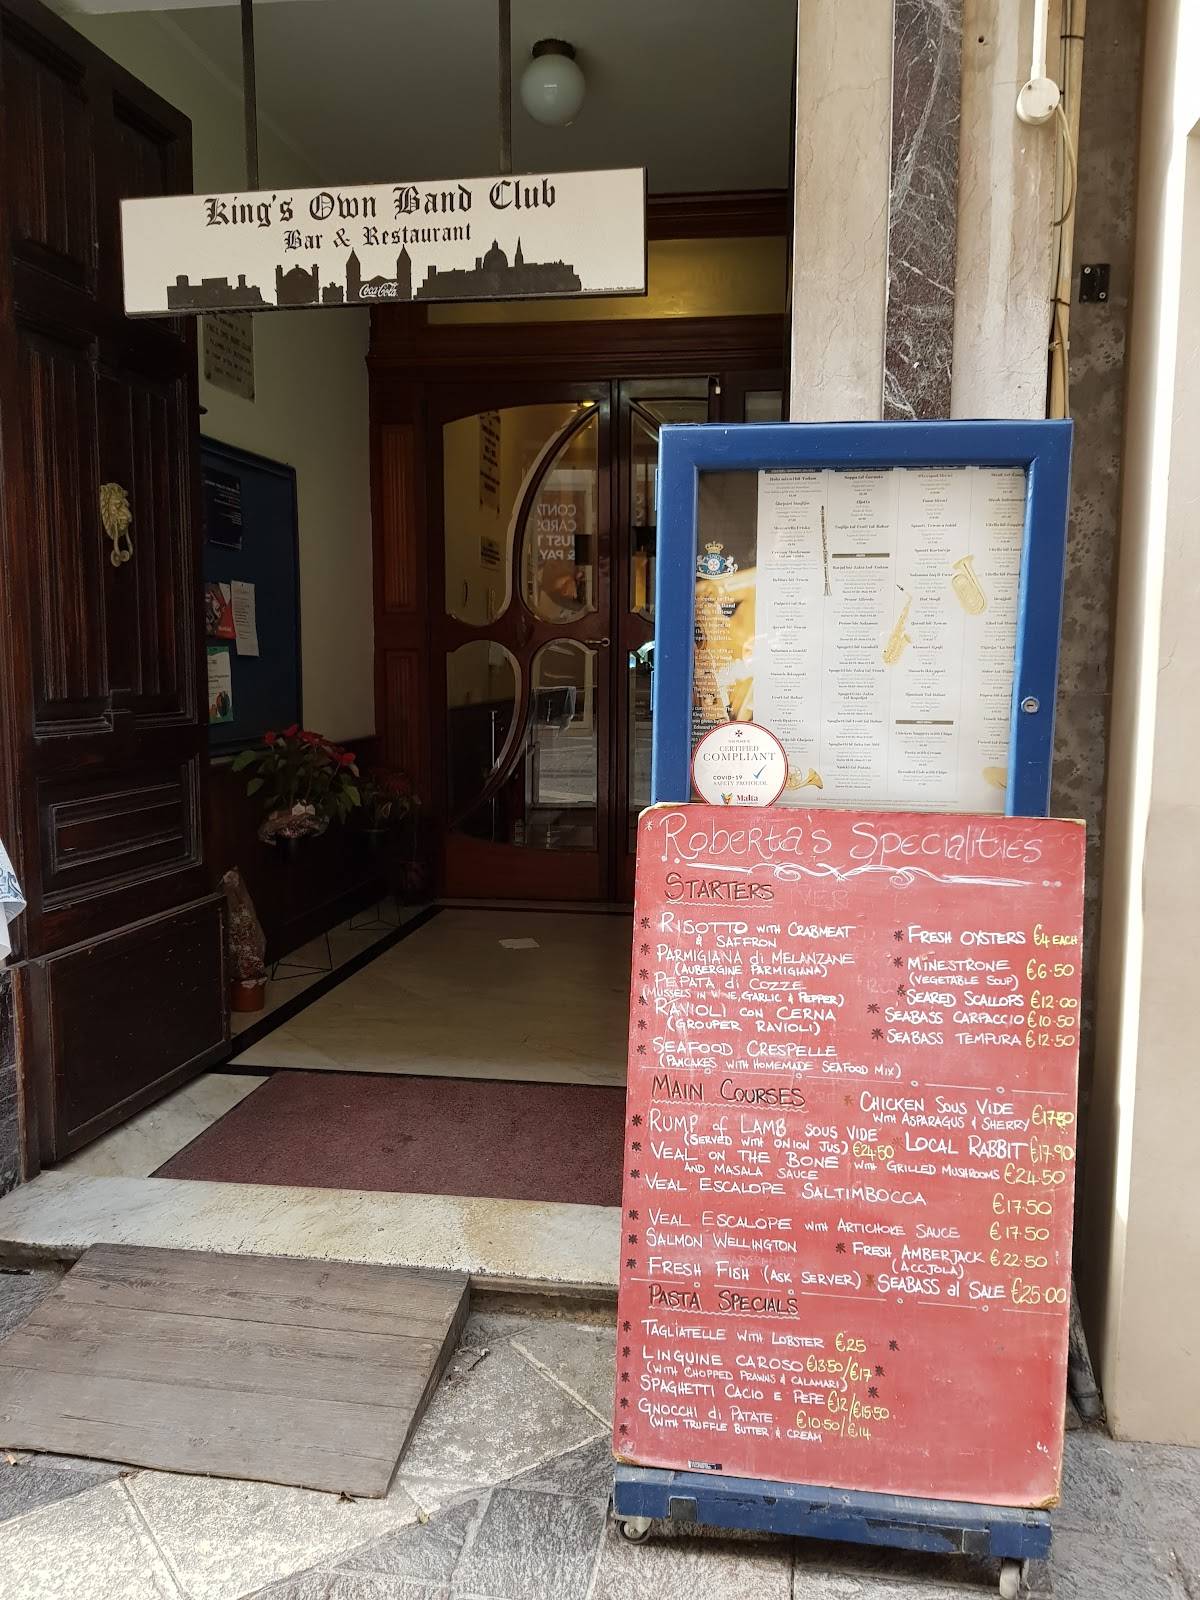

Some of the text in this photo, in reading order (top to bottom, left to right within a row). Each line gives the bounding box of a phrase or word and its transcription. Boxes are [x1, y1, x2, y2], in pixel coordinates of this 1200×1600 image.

[205, 178, 556, 227] King's Own Band Club
[284, 223, 471, 251] Bar & Restaurant
[703, 752, 776, 761] COMPLIANT
[664, 872, 774, 902] STARTERS
[661, 912, 748, 934] RISOTTO
[788, 922, 856, 938] CRABMEAT
[908, 924, 1078, 948] FRESH OYSTERS €4 EACH
[656, 943, 855, 965] PARMIGIANA di MELANZANE
[716, 936, 777, 948] SAFFRON
[674, 963, 828, 977] (AUBERGINE PARMIGIANA)
[907, 957, 1011, 972] MINESTRONE
[654, 971, 807, 990] PEPATA di COZZE
[909, 974, 979, 987] (VEGETABLE
[986, 974, 1019, 991] SOUP)
[655, 998, 836, 1021] RAVIOLI CON CERNA
[799, 992, 845, 1006] PEPPER)
[905, 989, 956, 1008] SEARED
[963, 991, 1024, 1007] SCALLOPS
[666, 1016, 821, 1035] (GROUPER RAVIOLI)
[884, 1007, 944, 1024] SEABASS
[952, 1011, 1025, 1024] CARPACCIO
[652, 1036, 837, 1057] SEAFOOD CRESPELLE
[886, 1029, 944, 1045] SEABASS
[955, 1032, 1022, 1046] TEMPURA
[659, 1053, 717, 1067] (PANCAKES
[725, 1060, 749, 1069] WITH
[753, 1060, 814, 1071] HOMEMADE
[822, 1060, 868, 1074] SEAFOOD
[652, 1074, 806, 1108] MAIN COURSES
[860, 1090, 1014, 1115] CHICKEN SOUS VIDE
[649, 1108, 699, 1133] RUMP
[740, 1114, 787, 1137] LAMB
[804, 1124, 838, 1138] SOUS
[846, 1126, 879, 1142] VIDE
[901, 1113, 965, 1129] ASPARAGUS
[981, 1117, 1030, 1132] SHERRY
[683, 1133, 732, 1146] (SERVED
[773, 1140, 810, 1151] ONION
[819, 1141, 849, 1155] JUS)
[905, 1132, 959, 1155] LOCAL
[968, 1135, 1029, 1160] RABBIT
[650, 1141, 698, 1162] VEAL
[708, 1151, 725, 1161] ON
[737, 1149, 771, 1164] THE
[785, 1152, 839, 1169] BONE
[886, 1160, 936, 1175] GRILLED
[942, 1165, 1000, 1180] MUSHROOMS
[684, 1164, 819, 1180] AND MASALA SAUCE
[645, 1172, 688, 1191] VEAL
[699, 1177, 786, 1195] ESCALOPE
[801, 1182, 928, 1205] SALTIMBOCCA
[648, 1208, 691, 1227] VEAL
[701, 1210, 793, 1229] ESCALOPE
[837, 1218, 906, 1236] ARTICHOKE
[916, 1224, 961, 1239] SAUCE
[646, 1227, 703, 1248] SALMON
[712, 1232, 798, 1253] WELLINGTON
[852, 1242, 892, 1258] FRESH
[901, 1244, 985, 1264] AMBERJACK
[648, 1256, 701, 1277] FRESH
[715, 1260, 750, 1281] FISH
[763, 1265, 793, 1284] (ASK
[801, 1270, 861, 1290] SERVER)
[877, 1273, 940, 1295] SEABASS
[968, 1281, 1007, 1300] SALE
[649, 1283, 799, 1315] PASTA SPECIALS
[641, 1319, 867, 1352] TAGLIATELLE WITH LOBSTER €25
[642, 1346, 723, 1366] LINGUINE
[735, 1355, 803, 1372] CAROSO
[684, 1366, 734, 1381] CHOPPED
[740, 1372, 776, 1384] PRAWNS
[640, 1375, 715, 1398] SPAGHETTI
[724, 1384, 764, 1401] CACIO
[774, 1391, 782, 1401] E
[794, 1390, 825, 1405] PEPE
[638, 1398, 698, 1418] GNOCCHI
[708, 1405, 722, 1419] di
[731, 1406, 773, 1423] PATATE
[684, 1419, 728, 1432] TRUFFLE
[734, 1424, 769, 1437] BUTTER
[787, 1428, 822, 1443] CREAM
